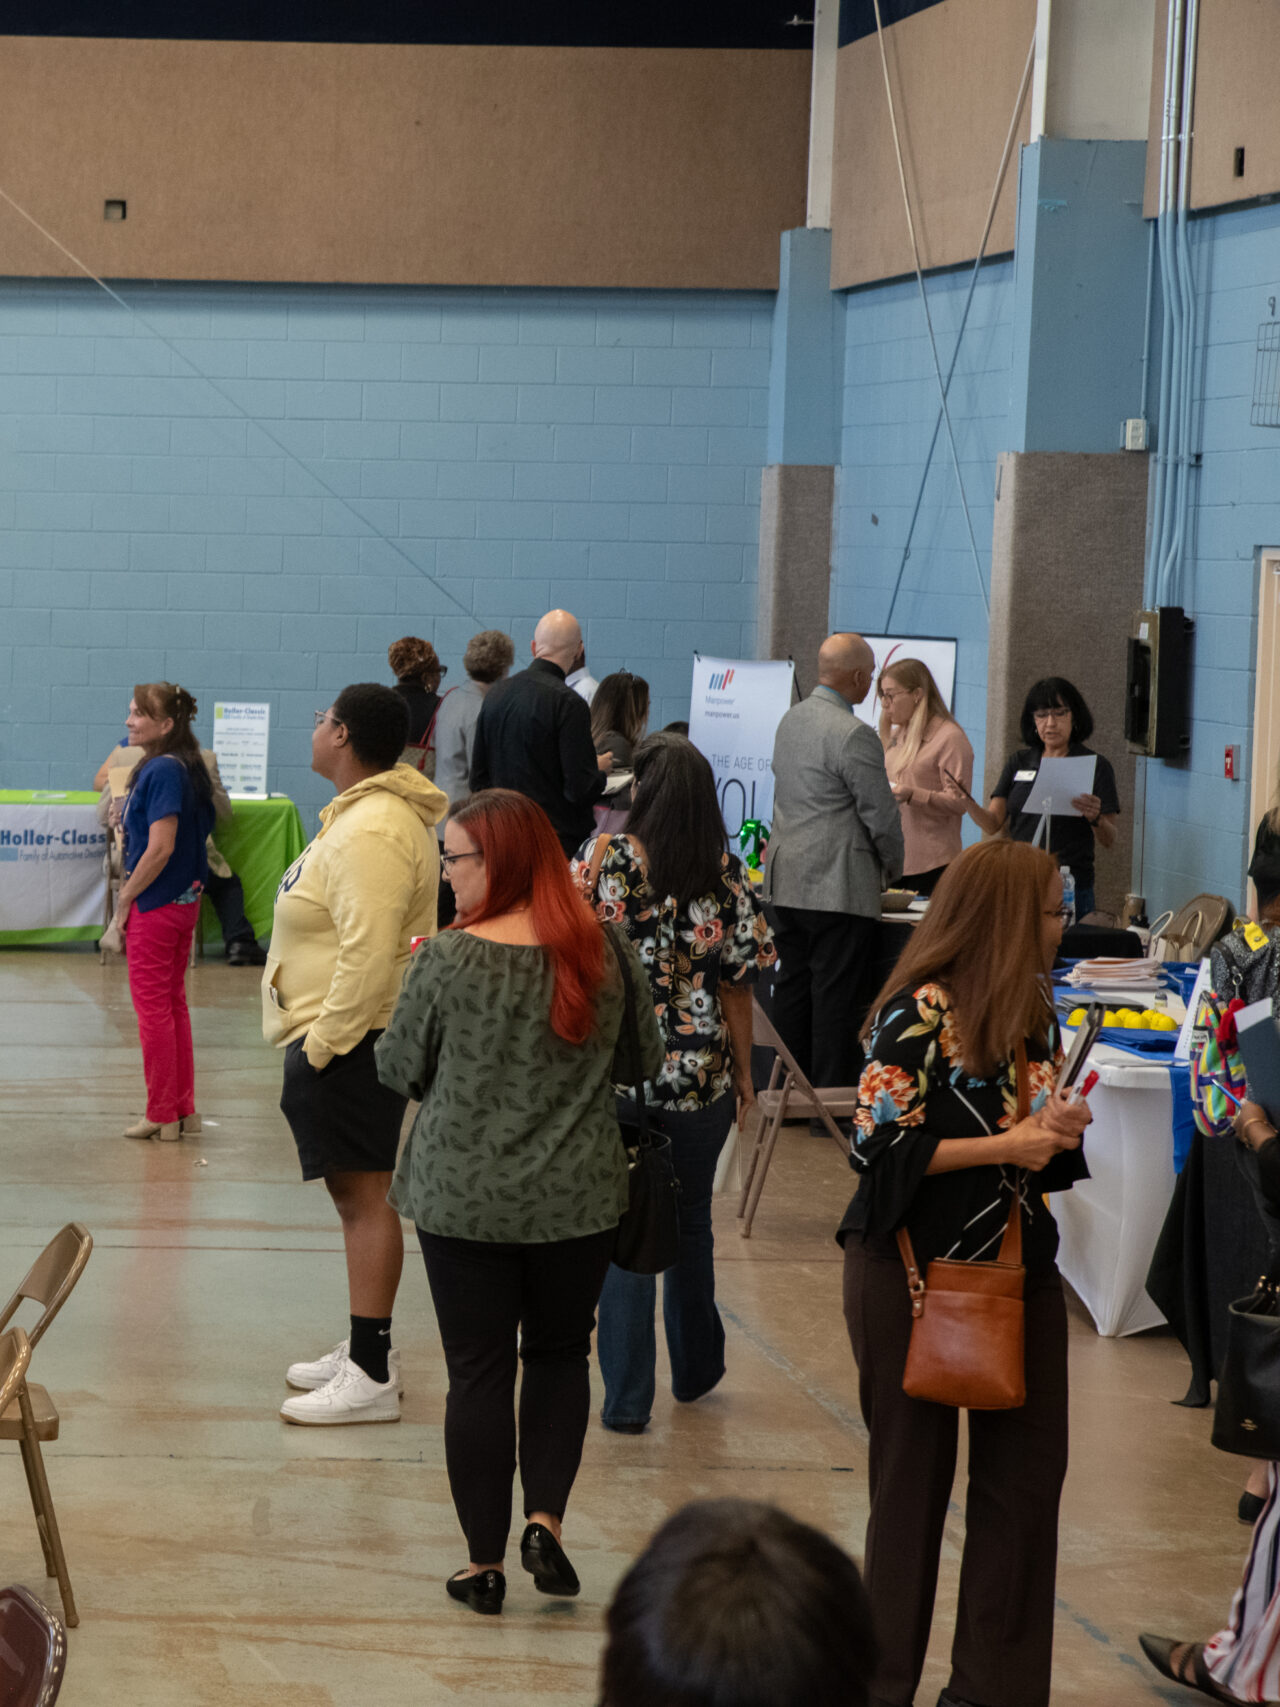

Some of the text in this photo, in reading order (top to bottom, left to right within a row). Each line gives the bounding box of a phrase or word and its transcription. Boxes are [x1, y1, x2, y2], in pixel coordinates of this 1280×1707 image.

[712, 754, 731, 769] THE
[733, 757, 754, 771] AGE
[0, 828, 107, 846] Holler-Class
[20, 848, 40, 863] Family
